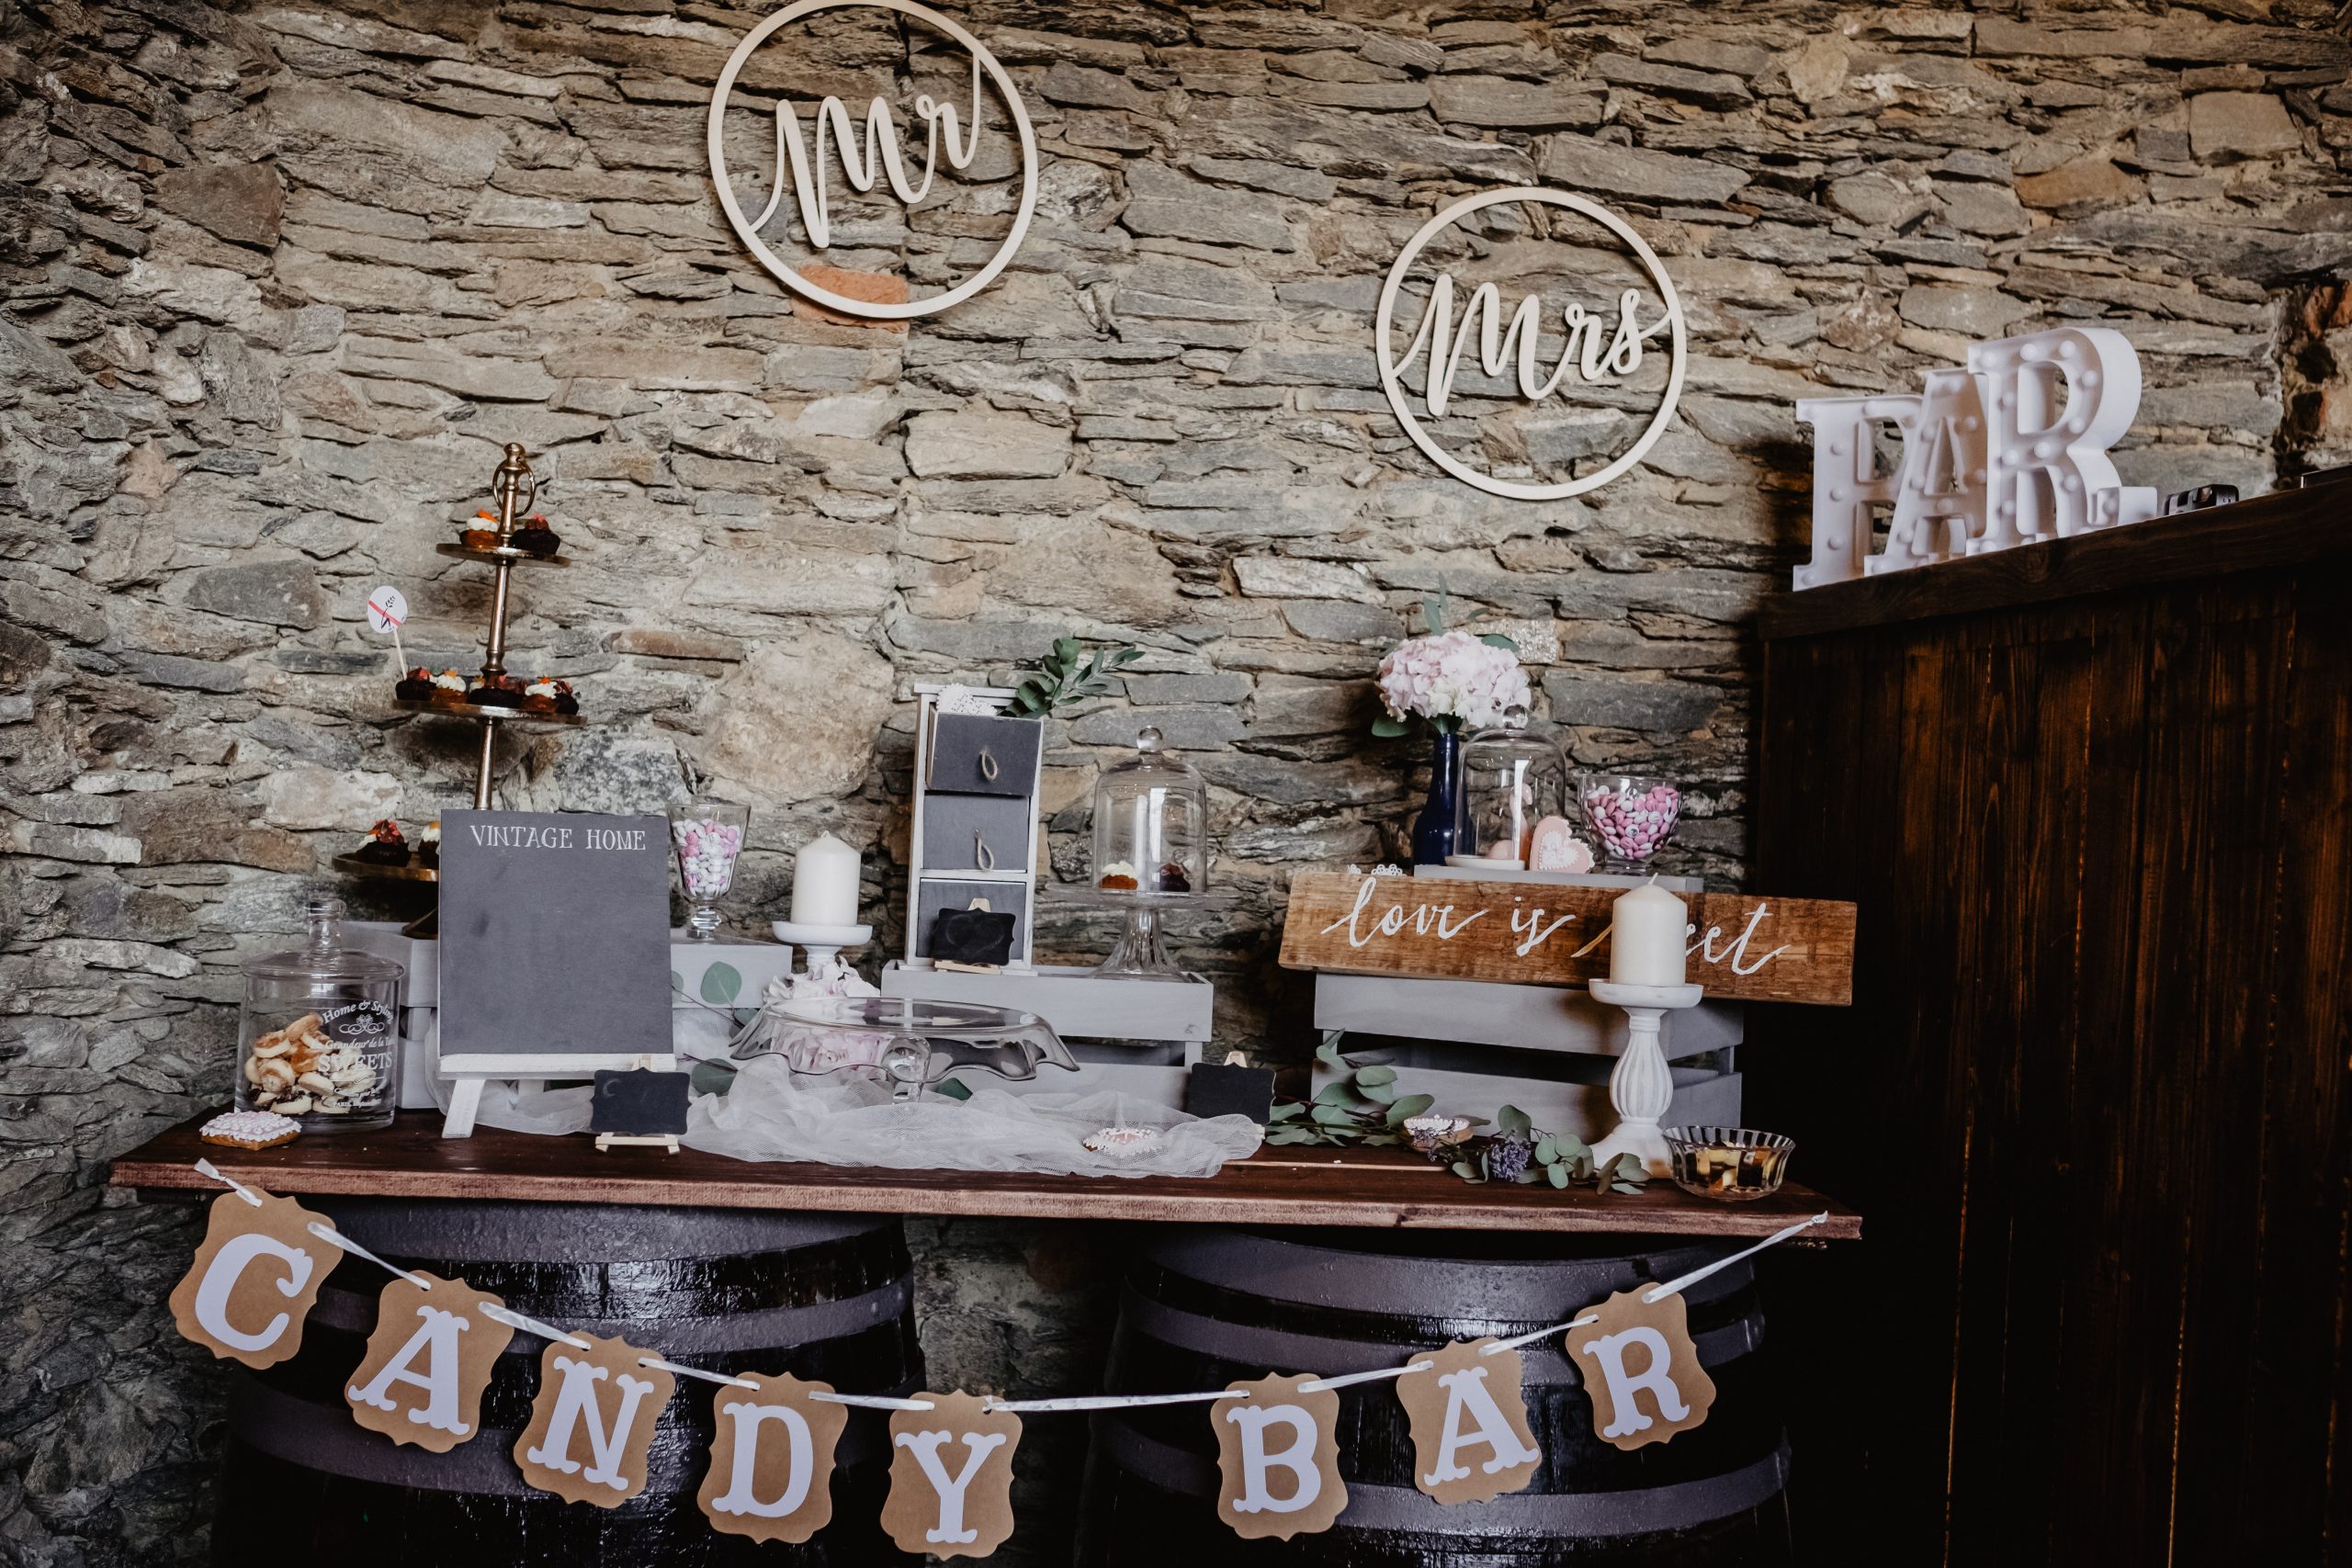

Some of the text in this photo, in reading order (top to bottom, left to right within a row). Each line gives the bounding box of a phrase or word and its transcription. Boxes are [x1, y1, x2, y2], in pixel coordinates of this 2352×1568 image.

[750, 51, 980, 248] Mr
[1393, 274, 1672, 416] Mrs
[470, 825, 646, 851] VINTAGE HOME
[1321, 876, 1490, 948] love
[1511, 896, 1577, 957] is
[322, 999, 394, 1025] Home & Styling
[194, 1233, 1690, 1545] CANDY BAR
